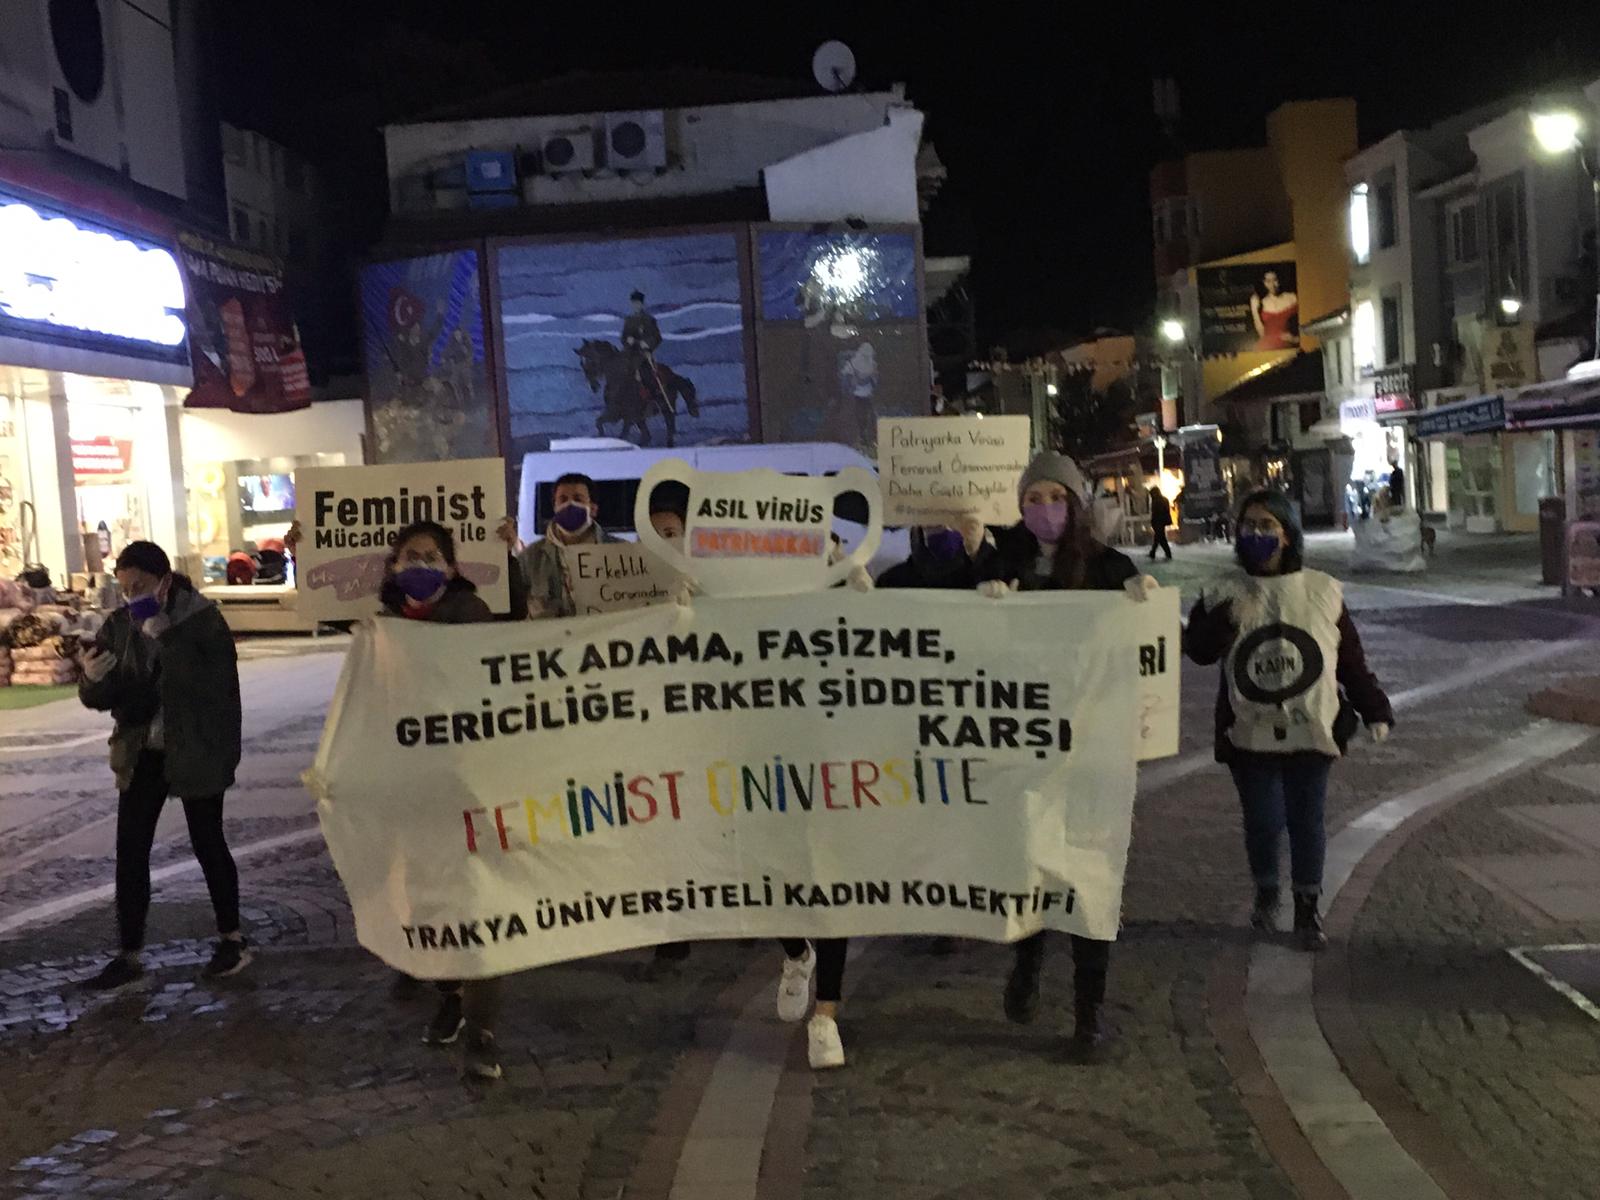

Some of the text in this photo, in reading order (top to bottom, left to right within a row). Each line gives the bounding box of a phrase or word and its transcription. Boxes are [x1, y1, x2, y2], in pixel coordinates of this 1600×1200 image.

[315, 485, 486, 527] Feminist
[697, 496, 823, 524] ASIL VİRÜS
[460, 523, 486, 542] ile
[481, 616, 955, 684] TEK ADAMA, FAŞİZME,
[396, 668, 1050, 747] GERİCİLİĞE, ERKEK ŞİDDETİNE
[918, 714, 1072, 759] KARŞI
[402, 875, 1076, 950] TRAKYA ÜNİVERSİTELİ KADIN KOLEKTİFİ
